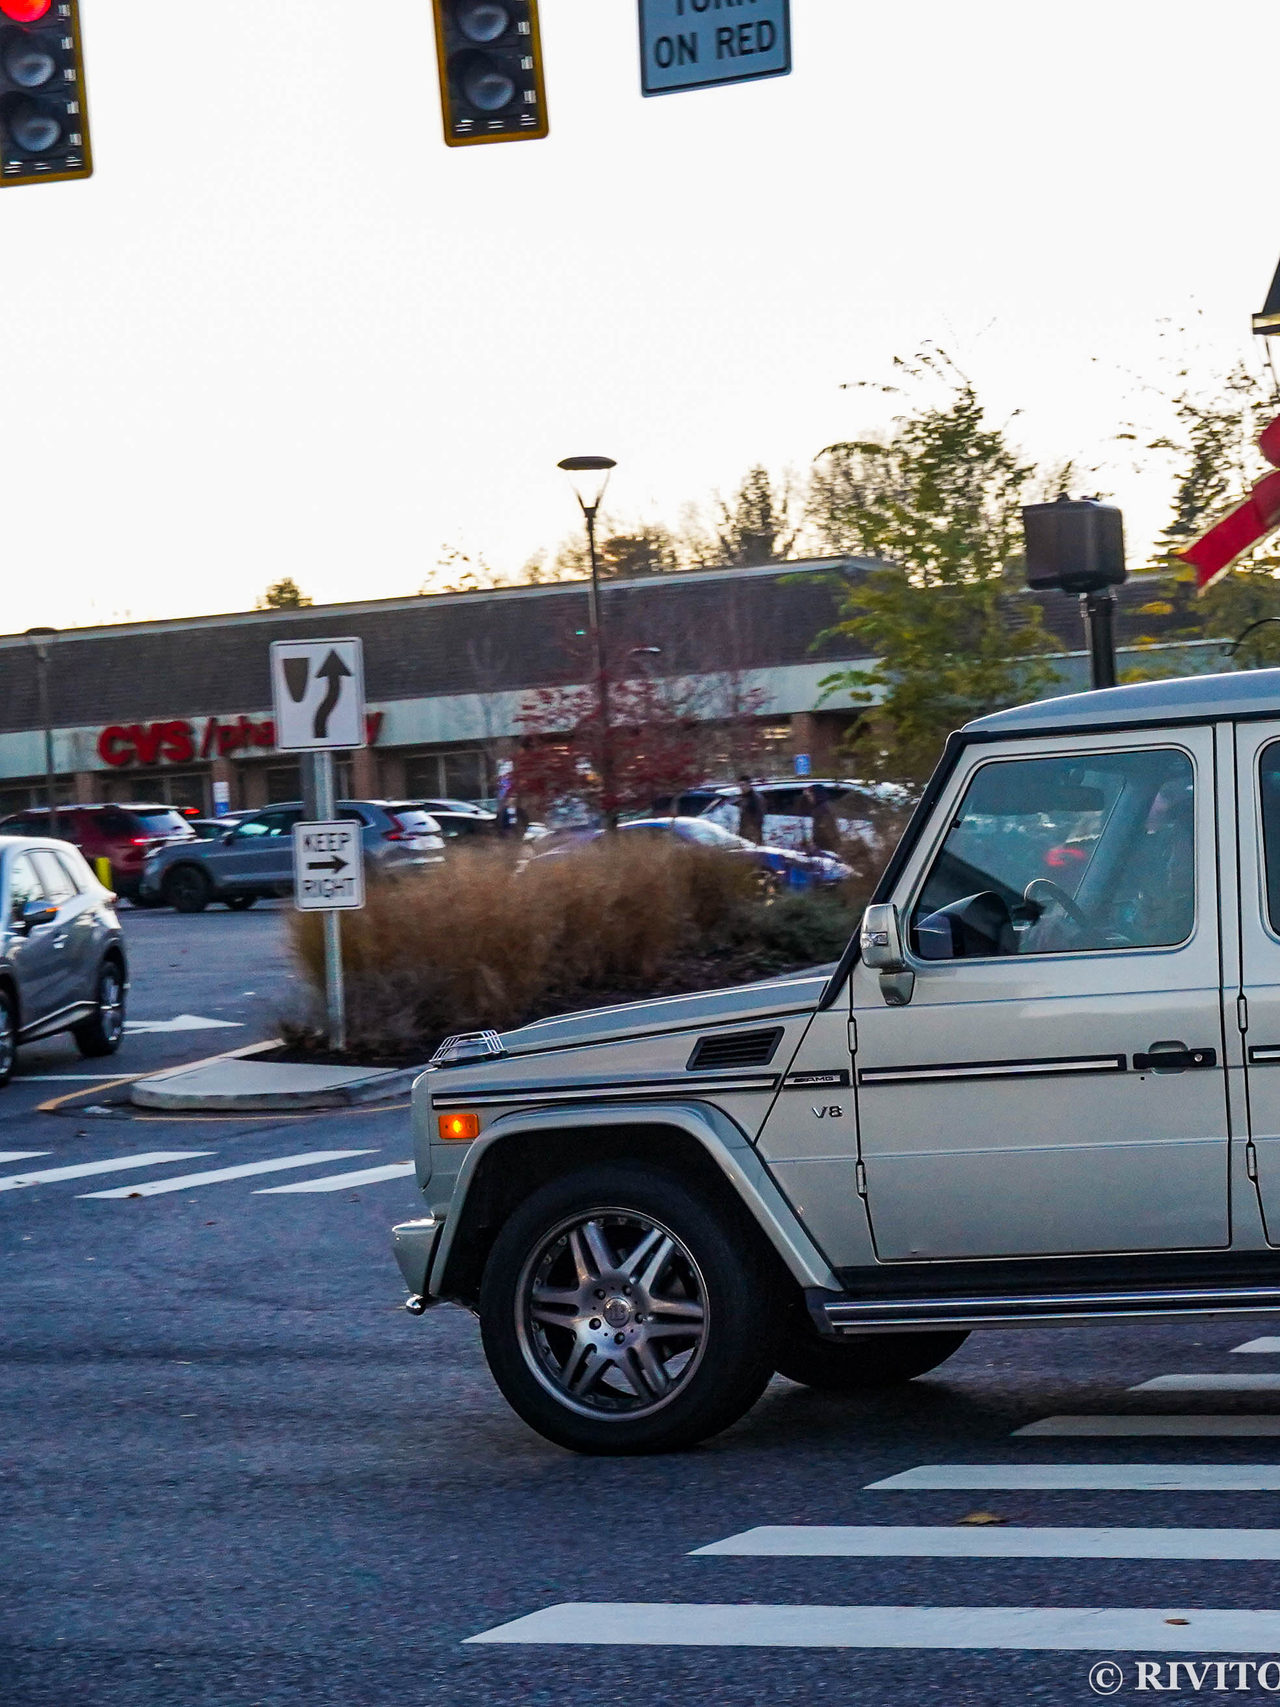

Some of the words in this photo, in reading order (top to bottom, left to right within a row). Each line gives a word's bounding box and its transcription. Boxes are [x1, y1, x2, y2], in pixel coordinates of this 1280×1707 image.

[653, 31, 698, 68] ON
[715, 20, 775, 59] RED
[303, 832, 351, 852] KEEP
[301, 877, 355, 898] RIGHT
[812, 1105, 843, 1118] V8
